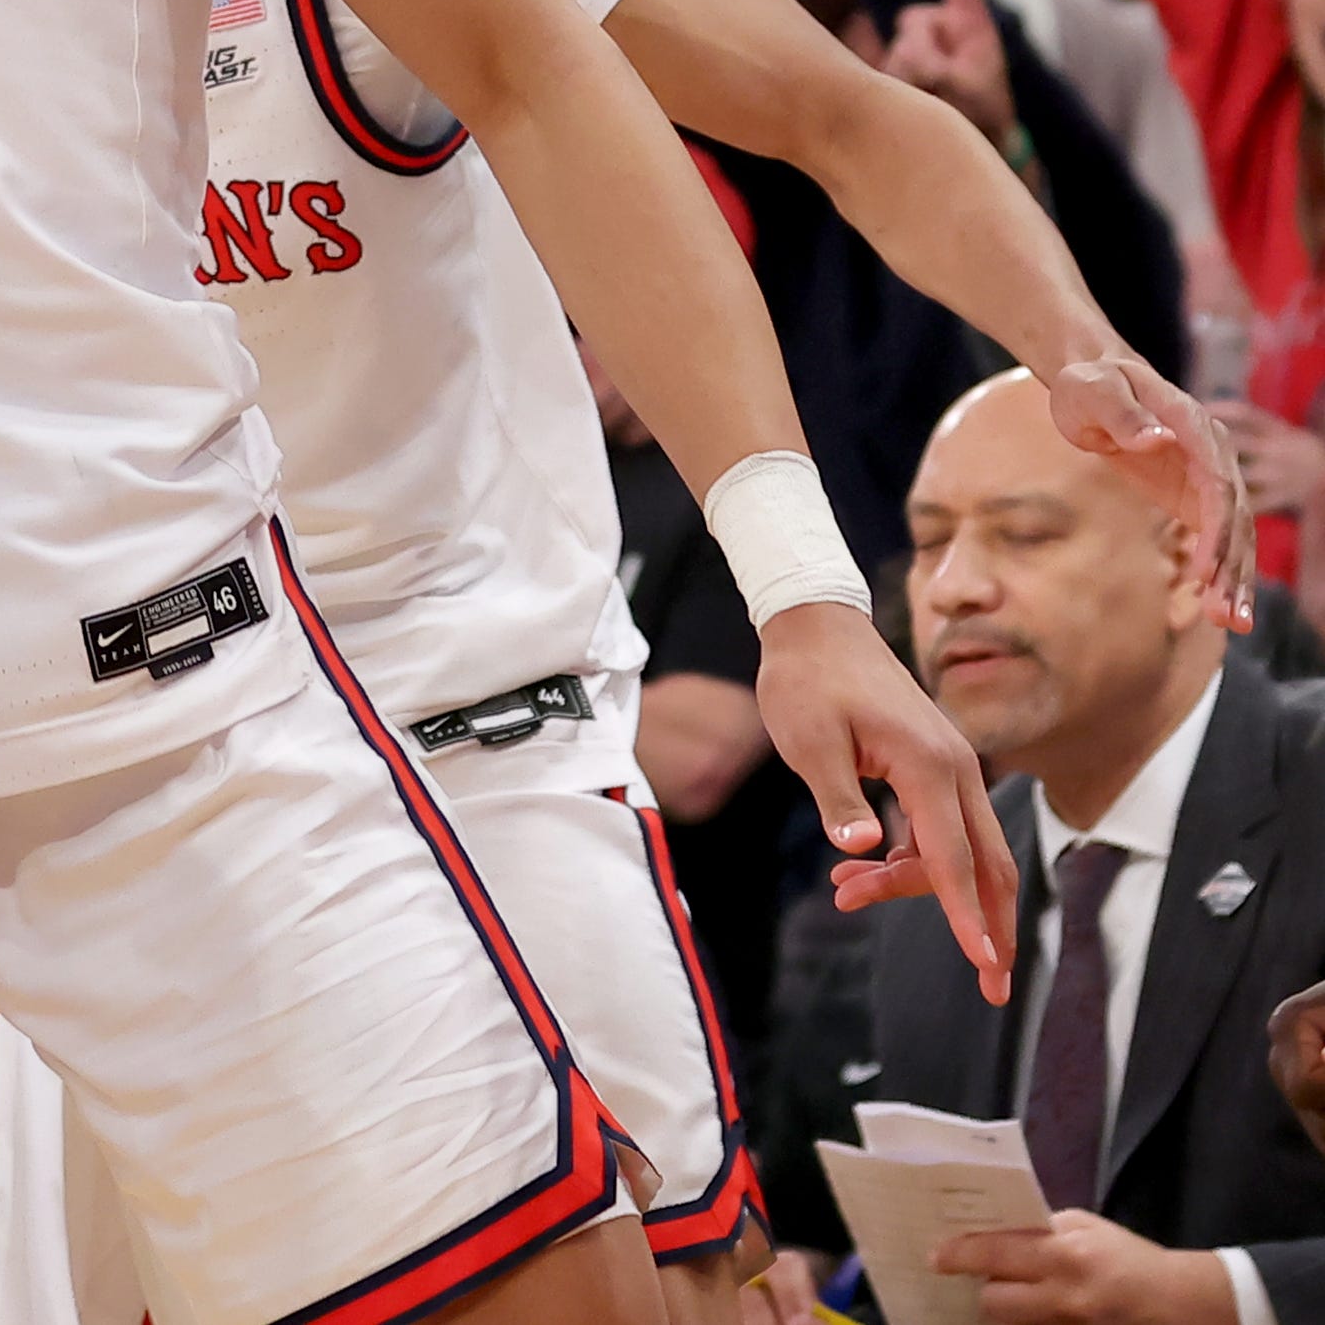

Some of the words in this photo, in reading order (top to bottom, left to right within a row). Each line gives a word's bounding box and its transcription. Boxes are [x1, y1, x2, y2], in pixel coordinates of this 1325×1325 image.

[204, 56, 256, 84] AST
[206, 45, 238, 69] IG
[193, 179, 363, 286] N'S
[213, 585, 238, 615] 46
[537, 687, 566, 706] 44
